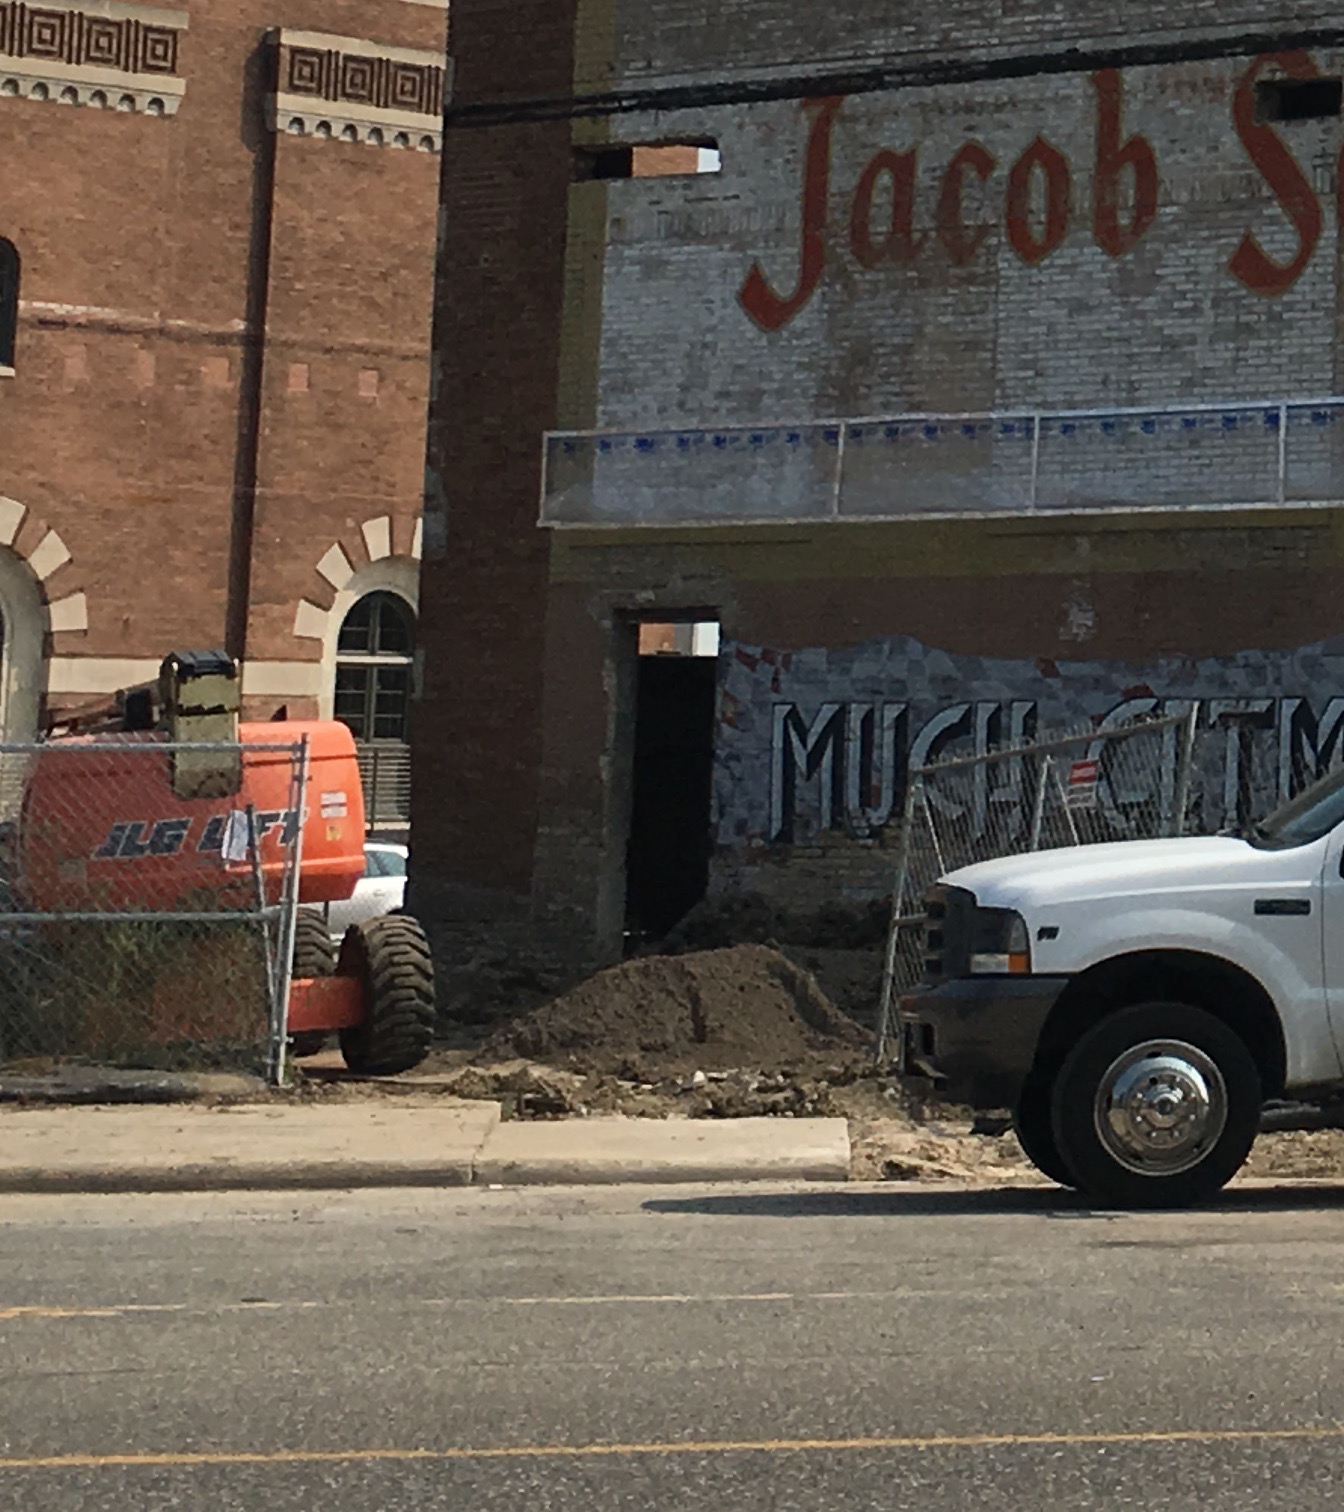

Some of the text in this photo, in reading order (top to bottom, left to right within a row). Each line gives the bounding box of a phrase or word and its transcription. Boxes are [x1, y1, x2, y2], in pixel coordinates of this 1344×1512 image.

[737, 67, 1160, 333] Jacob
[91, 807, 310, 859] JLG LFT
